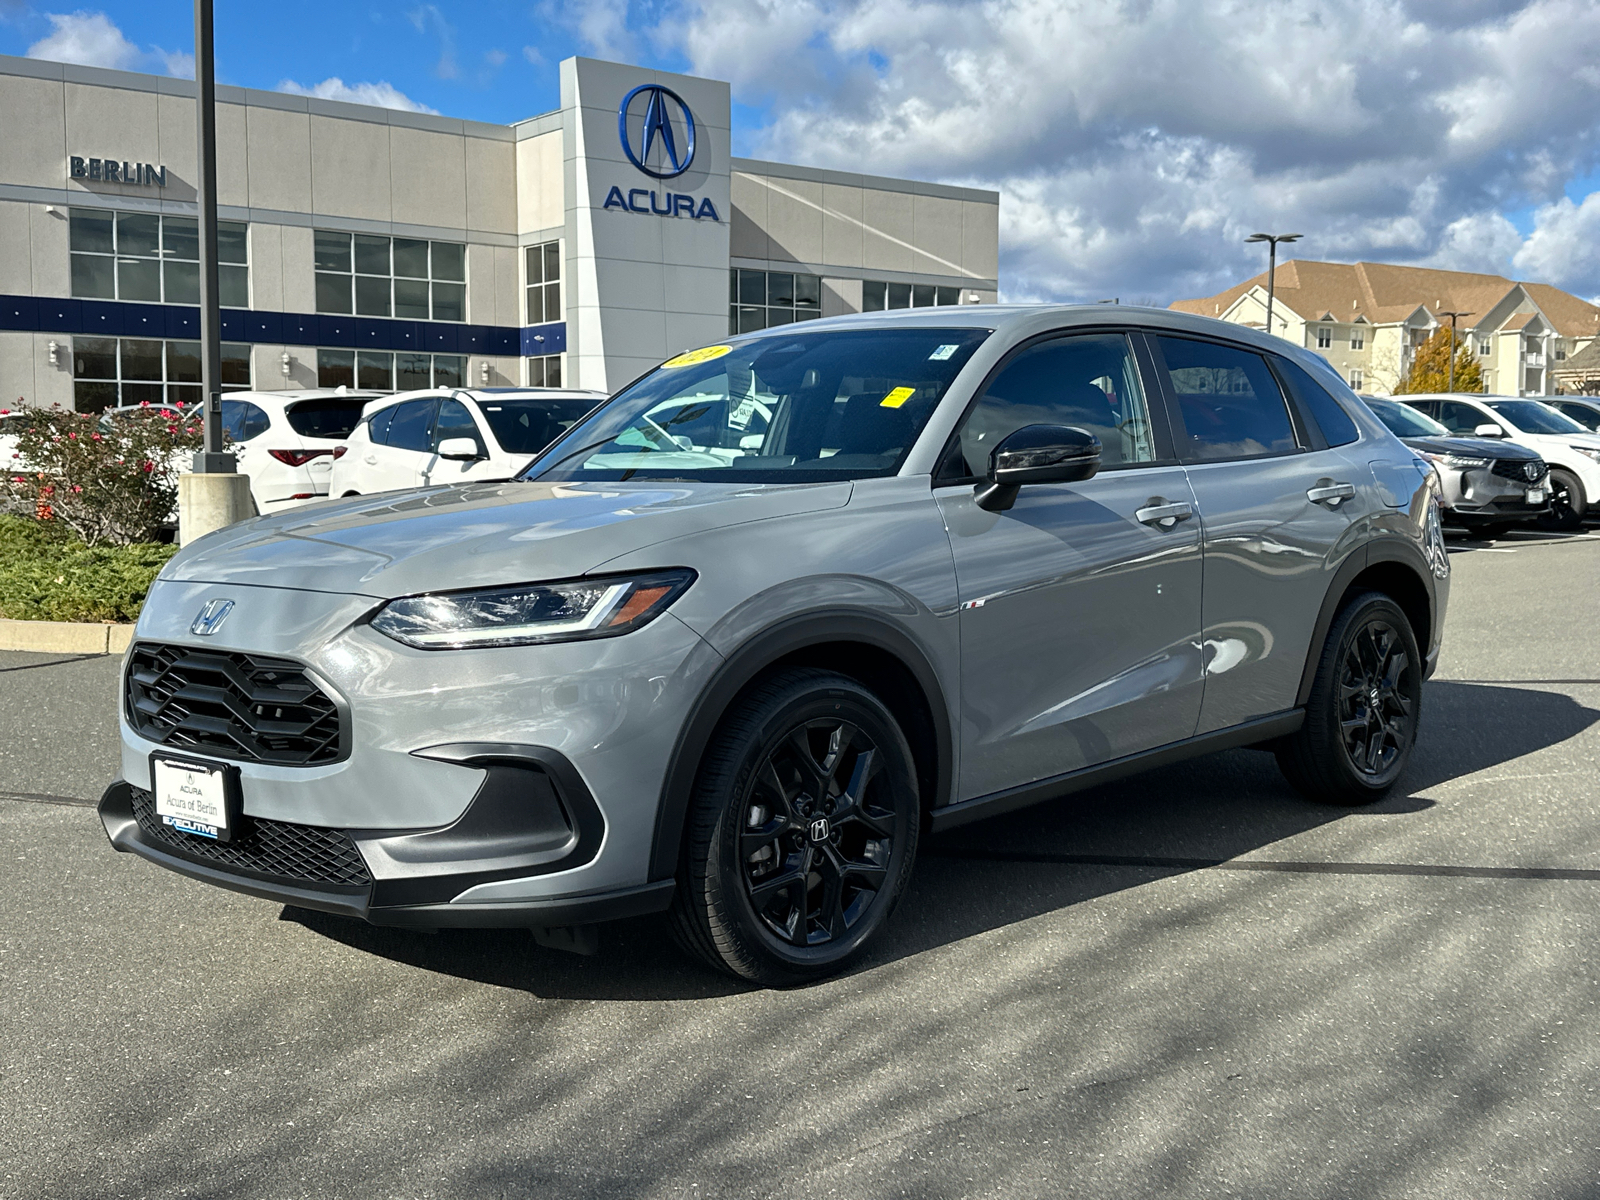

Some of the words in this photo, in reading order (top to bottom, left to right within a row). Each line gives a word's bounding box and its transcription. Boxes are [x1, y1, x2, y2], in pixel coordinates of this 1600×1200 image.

[69, 156, 167, 187] BERLIN
[603, 186, 719, 221] ACURA
[180, 785, 203, 796] ACURA
[166, 794, 187, 809] Acura
[187, 800, 196, 811] of
[197, 800, 218, 816] Berlin
[162, 816, 218, 836] EXECUTIVE
